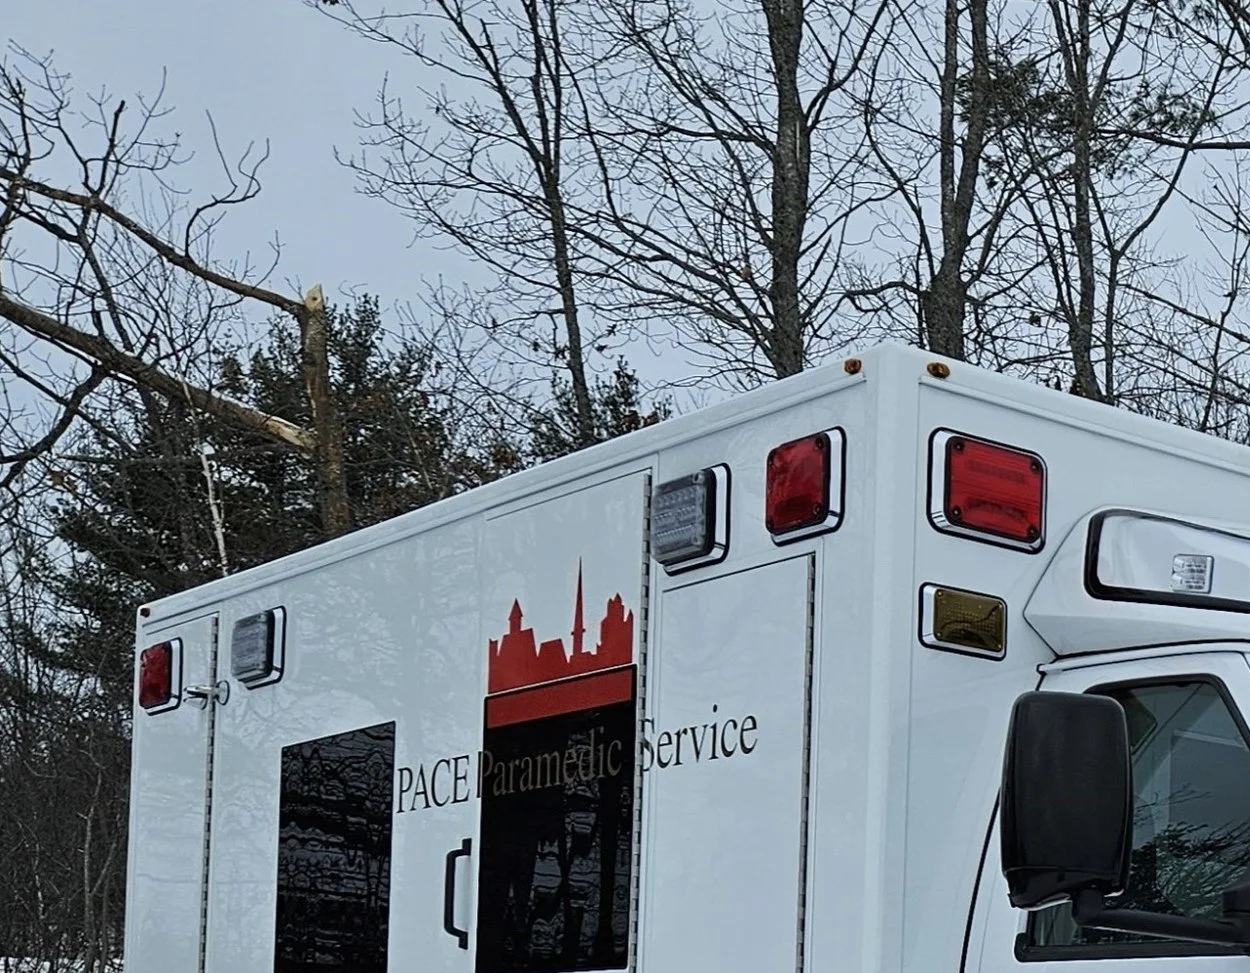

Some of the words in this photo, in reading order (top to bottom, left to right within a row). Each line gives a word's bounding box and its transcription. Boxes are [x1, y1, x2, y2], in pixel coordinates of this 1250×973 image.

[396, 754, 470, 813] PACE
[476, 726, 623, 799] Paramedic
[640, 704, 758, 773] Service
